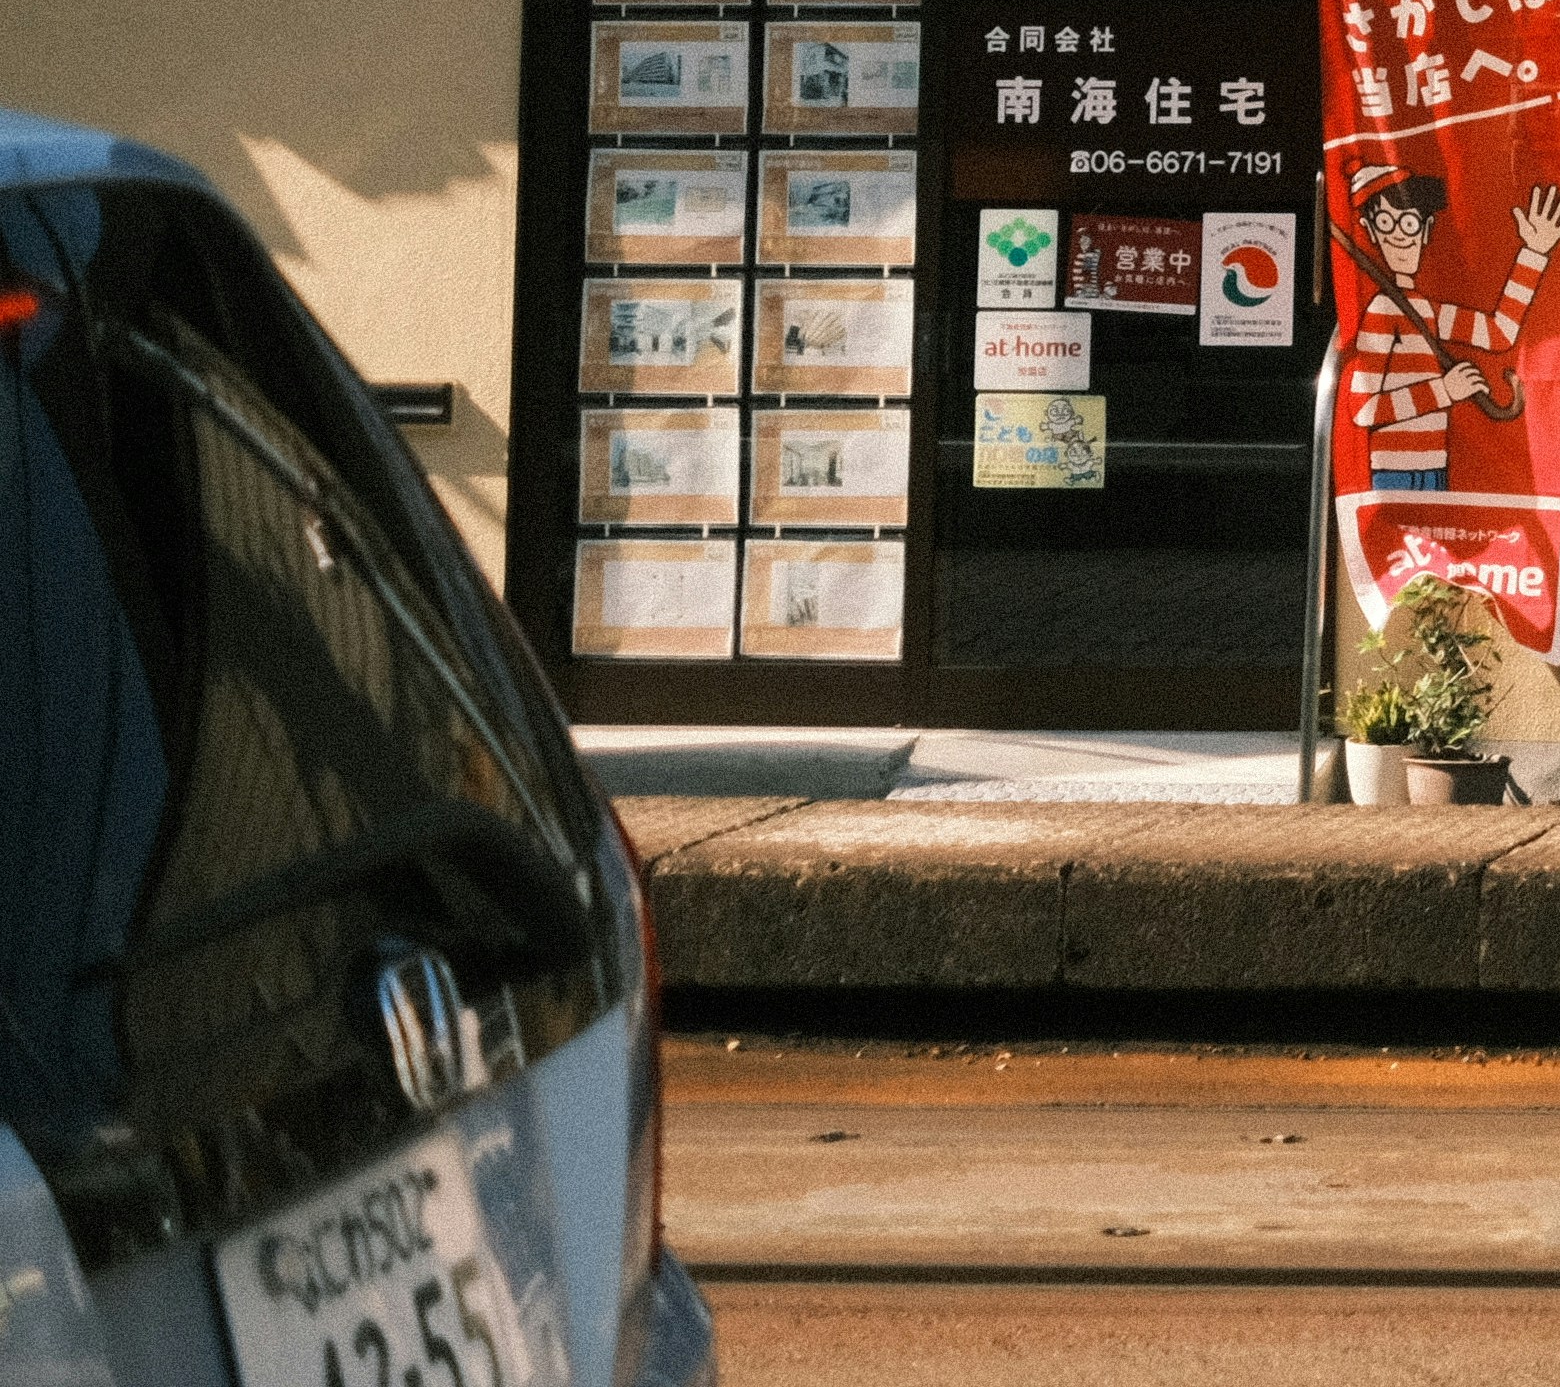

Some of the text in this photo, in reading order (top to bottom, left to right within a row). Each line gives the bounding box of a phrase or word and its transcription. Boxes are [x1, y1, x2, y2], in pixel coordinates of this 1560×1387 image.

[983, 26, 1116, 54] 合同会社
[1352, 48, 1540, 118] 当店へ。
[995, 75, 1267, 126] 南海住宅
[1090, 150, 1283, 175] 06-6671-7191
[1114, 244, 1192, 275] 営業中
[984, 334, 1082, 358] at home
[977, 424, 1034, 444] こども
[1386, 534, 1433, 578] at
